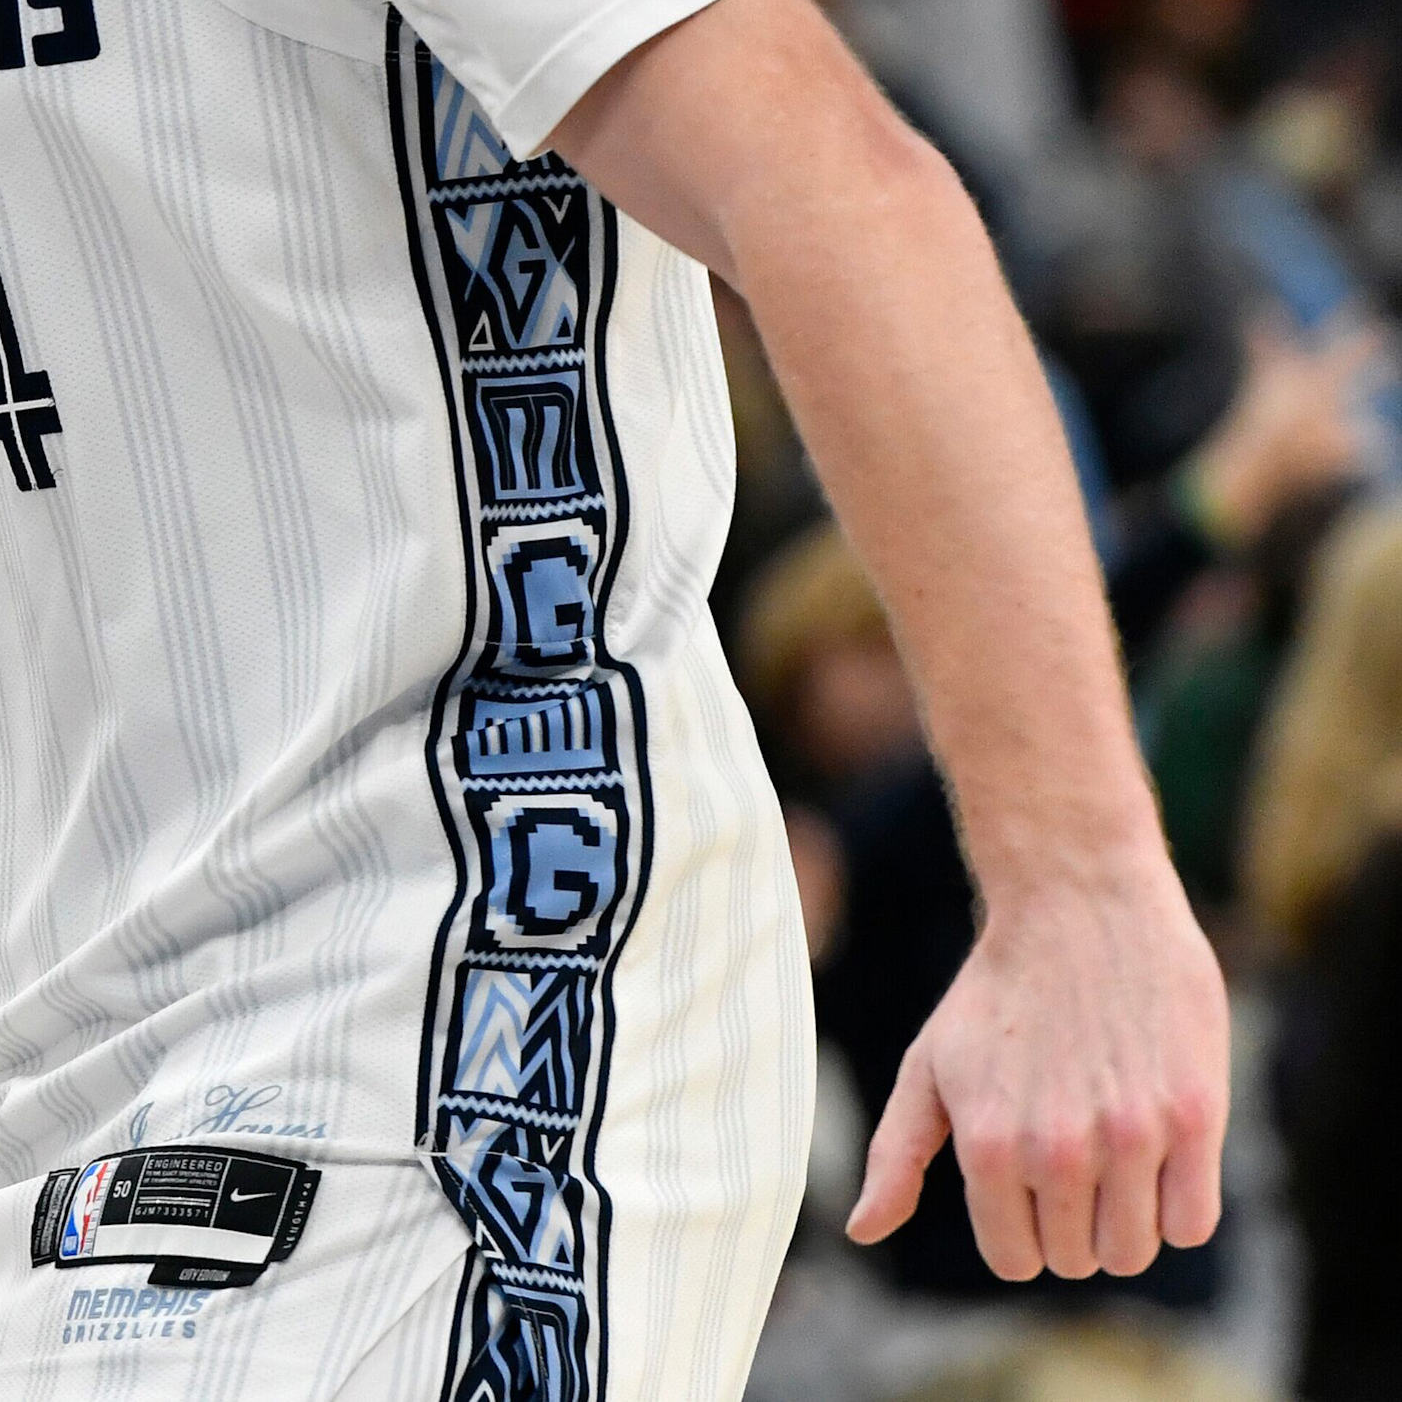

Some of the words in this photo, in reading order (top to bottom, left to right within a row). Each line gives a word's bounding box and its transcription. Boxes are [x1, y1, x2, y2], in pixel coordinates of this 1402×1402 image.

[146, 1159, 223, 1172] ENGINEERED
[112, 1180, 132, 1198] 50
[67, 1288, 213, 1321] MEMPHIS
[62, 1320, 197, 1345] GRIZZLIES
